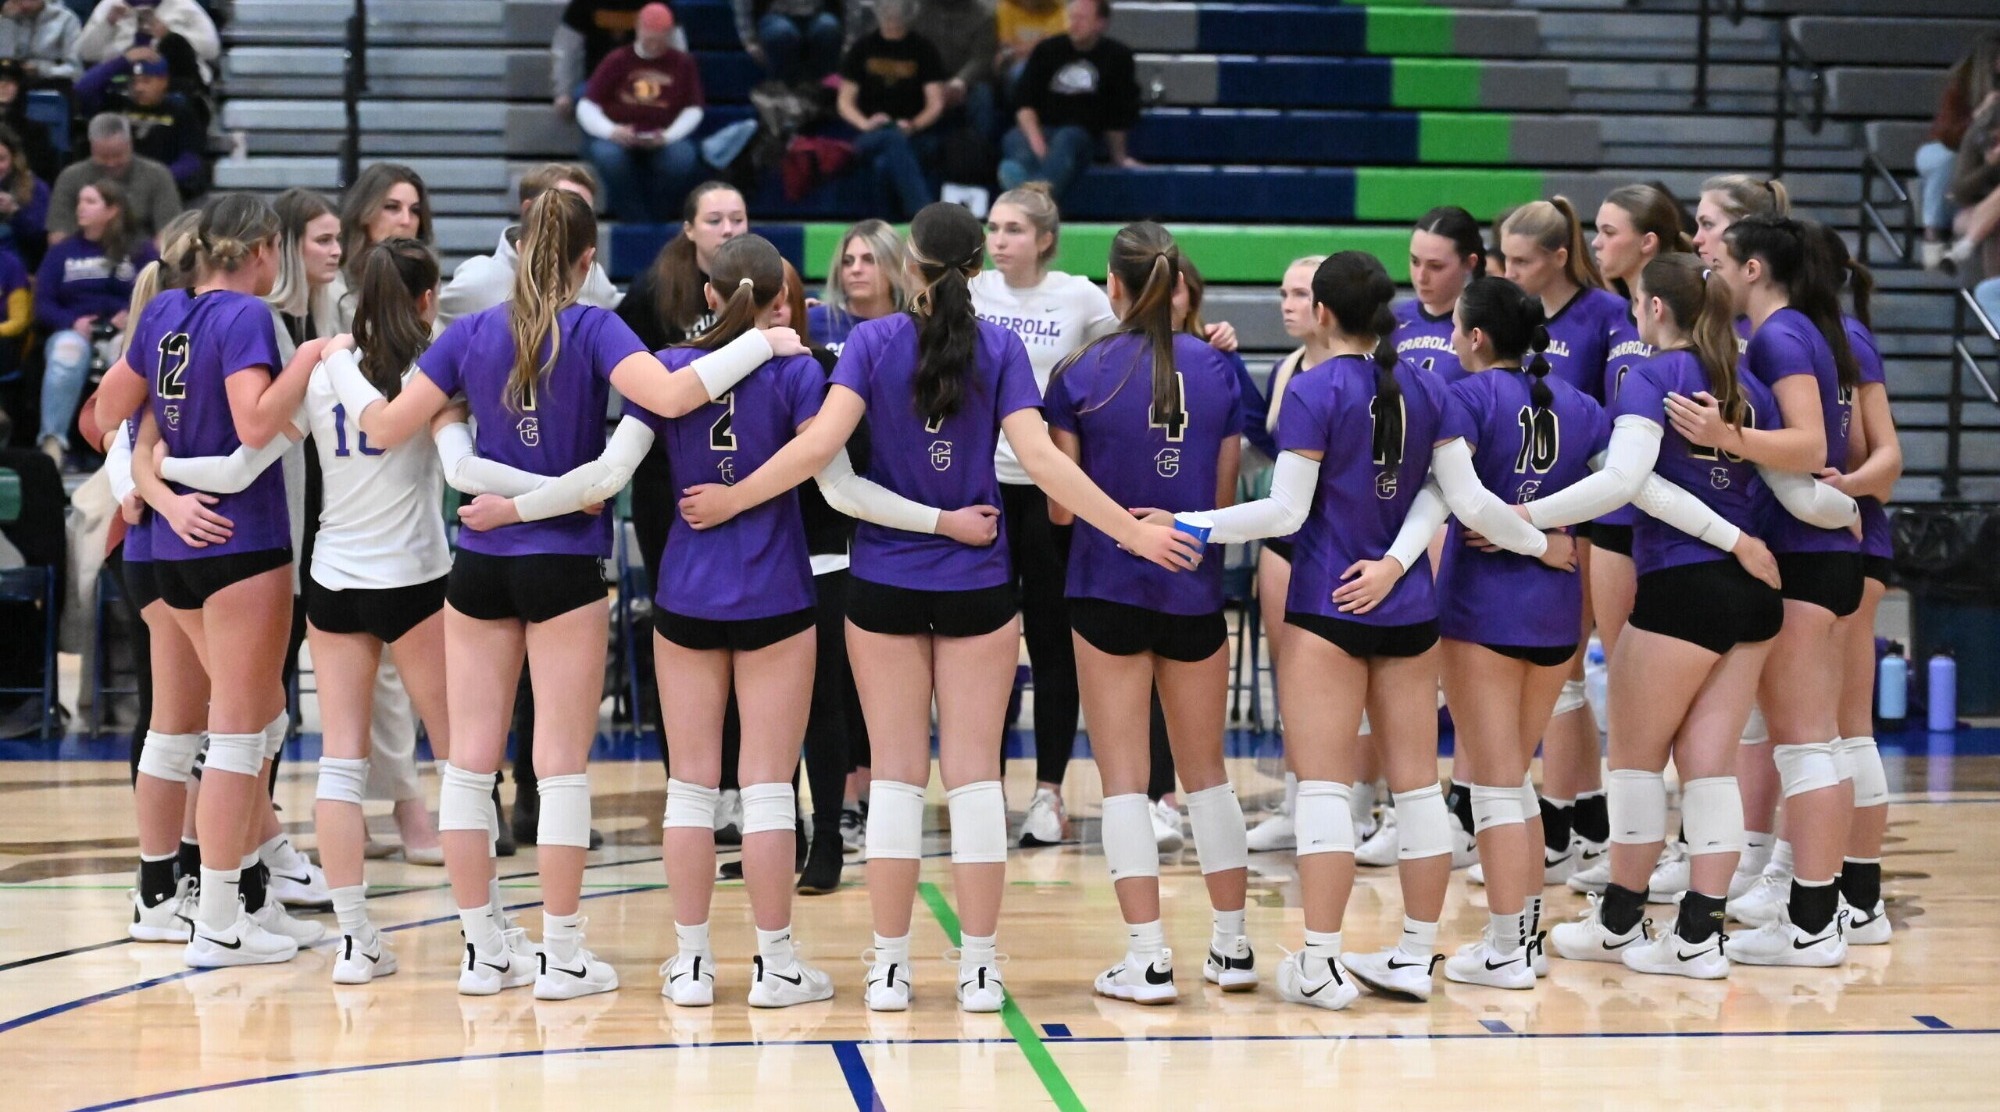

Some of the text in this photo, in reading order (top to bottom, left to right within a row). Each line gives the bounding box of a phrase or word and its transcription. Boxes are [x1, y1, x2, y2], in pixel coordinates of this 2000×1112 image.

[157, 330, 190, 400] 12
[1148, 371, 1189, 442] 4
[1513, 404, 1560, 475] 10
